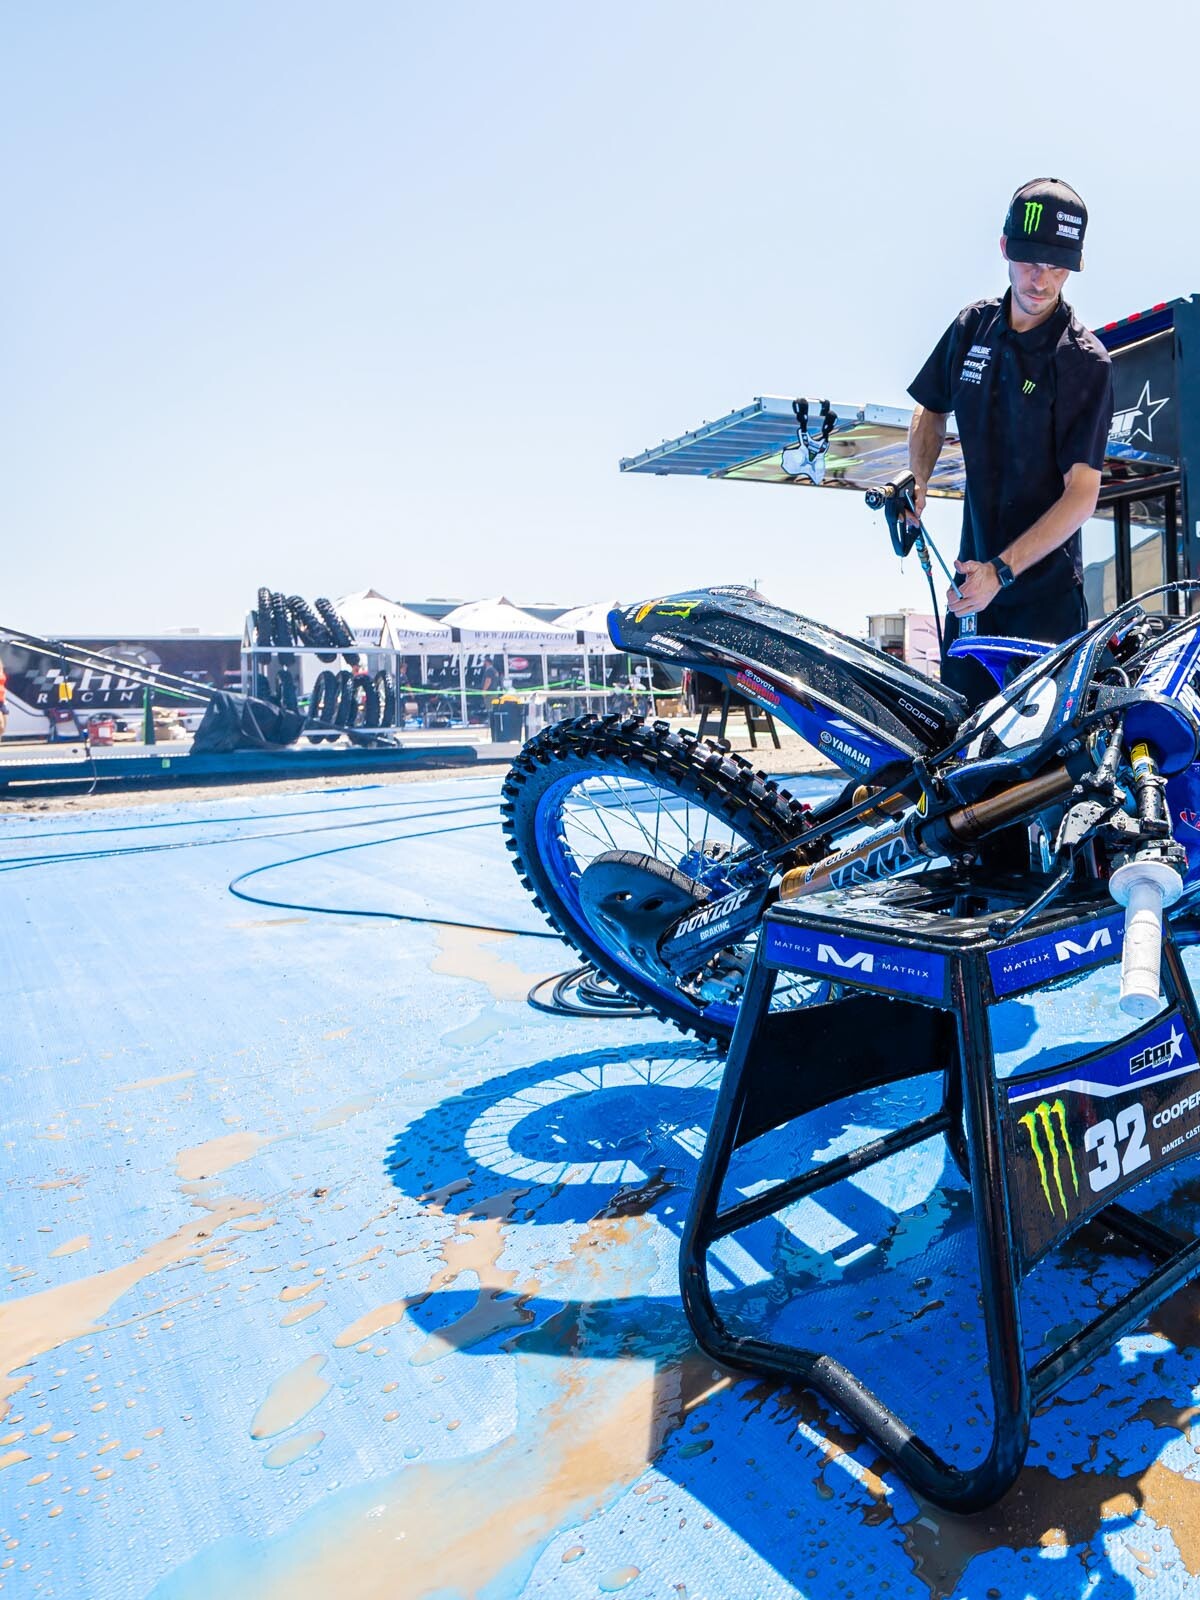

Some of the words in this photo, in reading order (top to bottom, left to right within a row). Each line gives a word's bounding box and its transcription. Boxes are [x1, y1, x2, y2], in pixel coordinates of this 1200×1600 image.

[752, 675, 775, 693] TOYOTA
[897, 697, 940, 730] COOPER
[832, 738, 871, 768] YAMAHA
[674, 890, 751, 939] DUNLOP
[700, 920, 731, 941] BRAKING
[774, 939, 812, 954] MATRIX
[882, 963, 930, 979] MATRIX
[1003, 953, 1051, 974] MATRIX
[1130, 1039, 1174, 1075] star
[1084, 1102, 1151, 1193] 32
[1161, 1135, 1185, 1156] DANIEL
